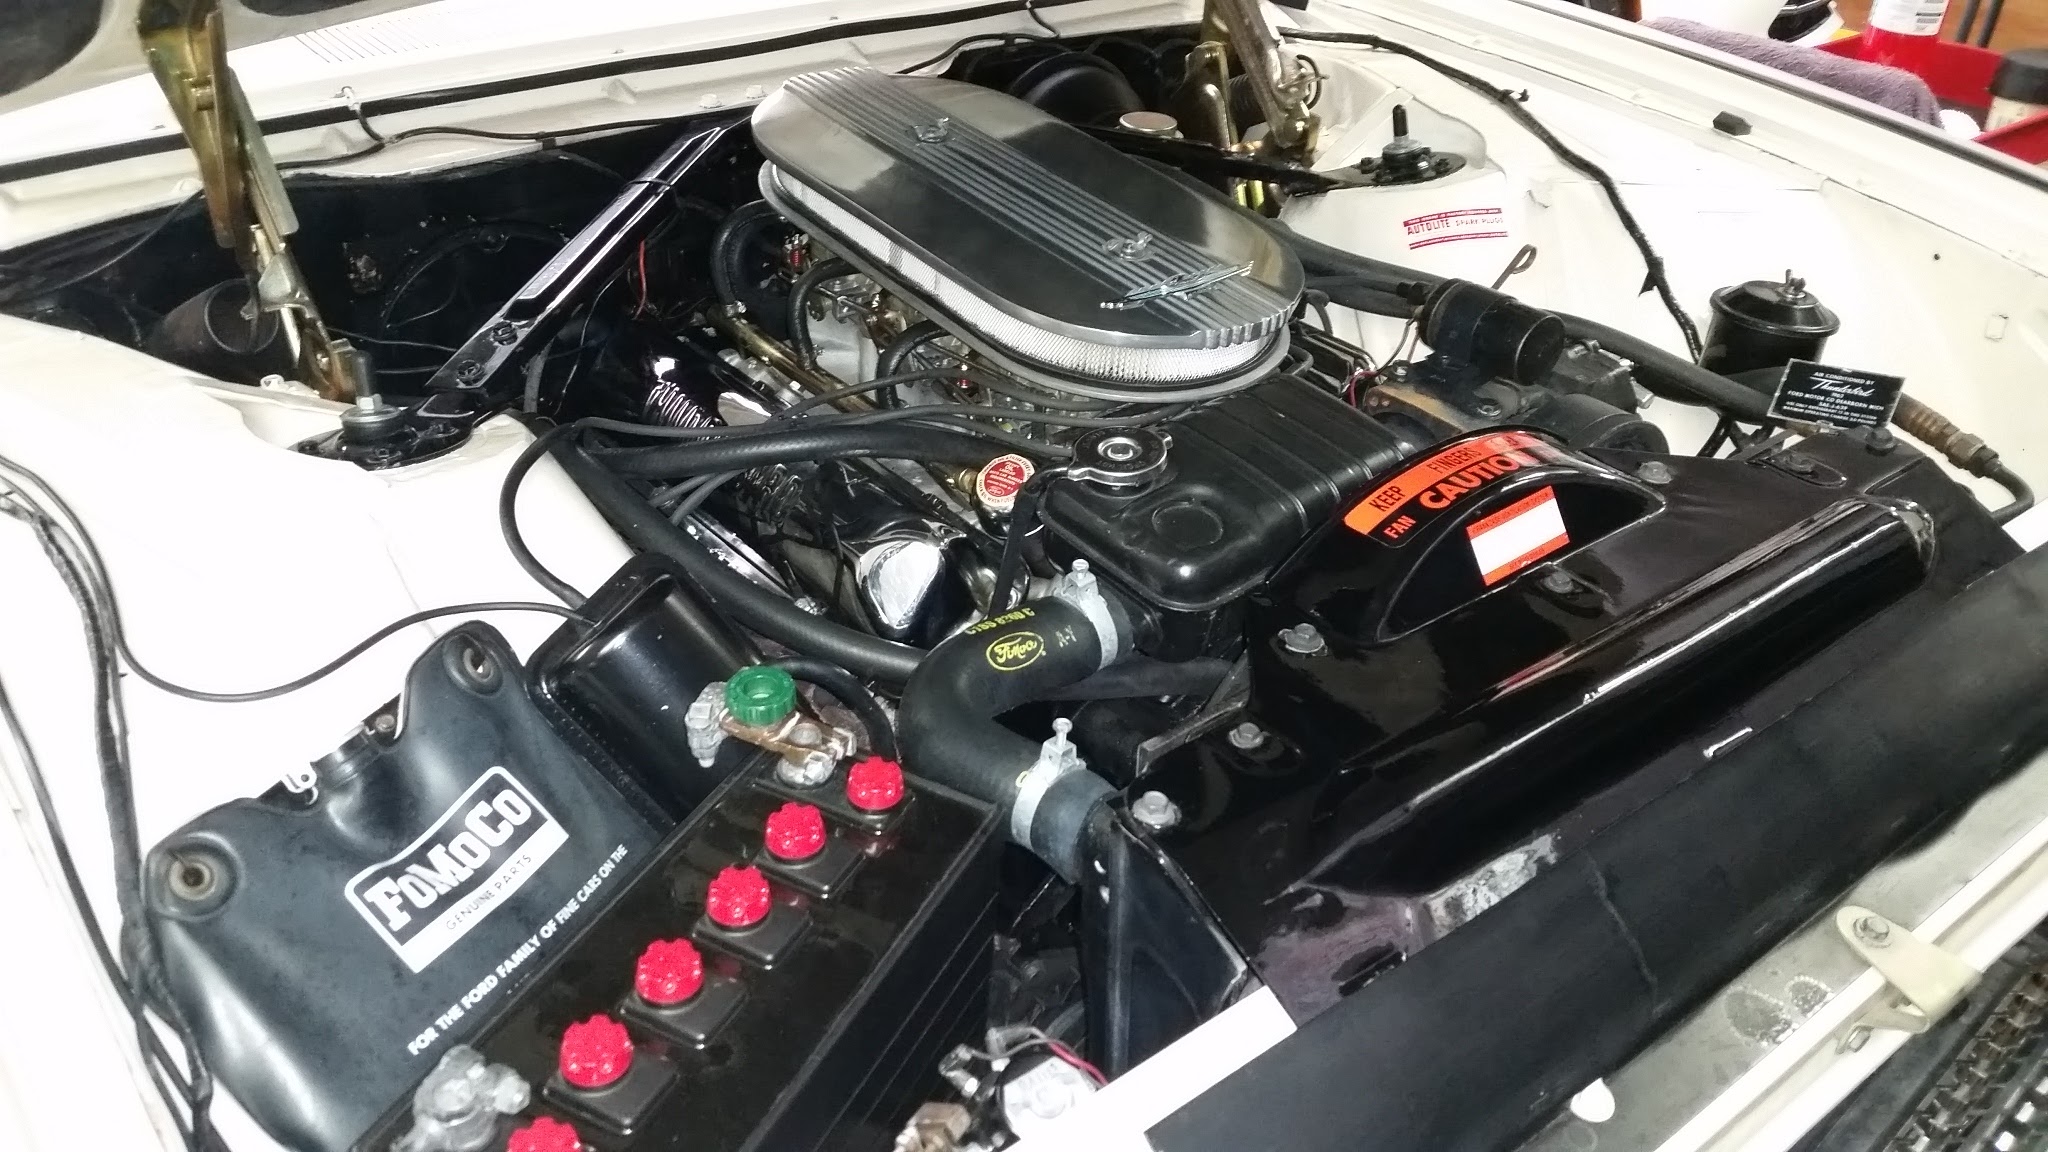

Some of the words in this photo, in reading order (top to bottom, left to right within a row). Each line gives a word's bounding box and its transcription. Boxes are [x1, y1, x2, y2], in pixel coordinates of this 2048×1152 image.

[1407, 219, 1451, 236] AUTOLITE
[1810, 376, 1876, 397] Thunderbird
[1369, 485, 1406, 512] KEEP
[1426, 447, 1483, 474] FINGERS
[1383, 515, 1416, 539] FAN
[363, 789, 532, 932] FoMoCo
[446, 889, 496, 930] GENUINE
[494, 854, 532, 891] PARTS
[407, 1027, 439, 1056] FOR
[435, 1003, 464, 1031] THE
[461, 974, 498, 1010] FORD
[495, 934, 541, 978] FAMILY
[540, 919, 557, 939] OF
[555, 898, 580, 925] FINE
[576, 873, 603, 902] CARS
[598, 860, 616, 878] ON
[613, 843, 628, 864] THE
